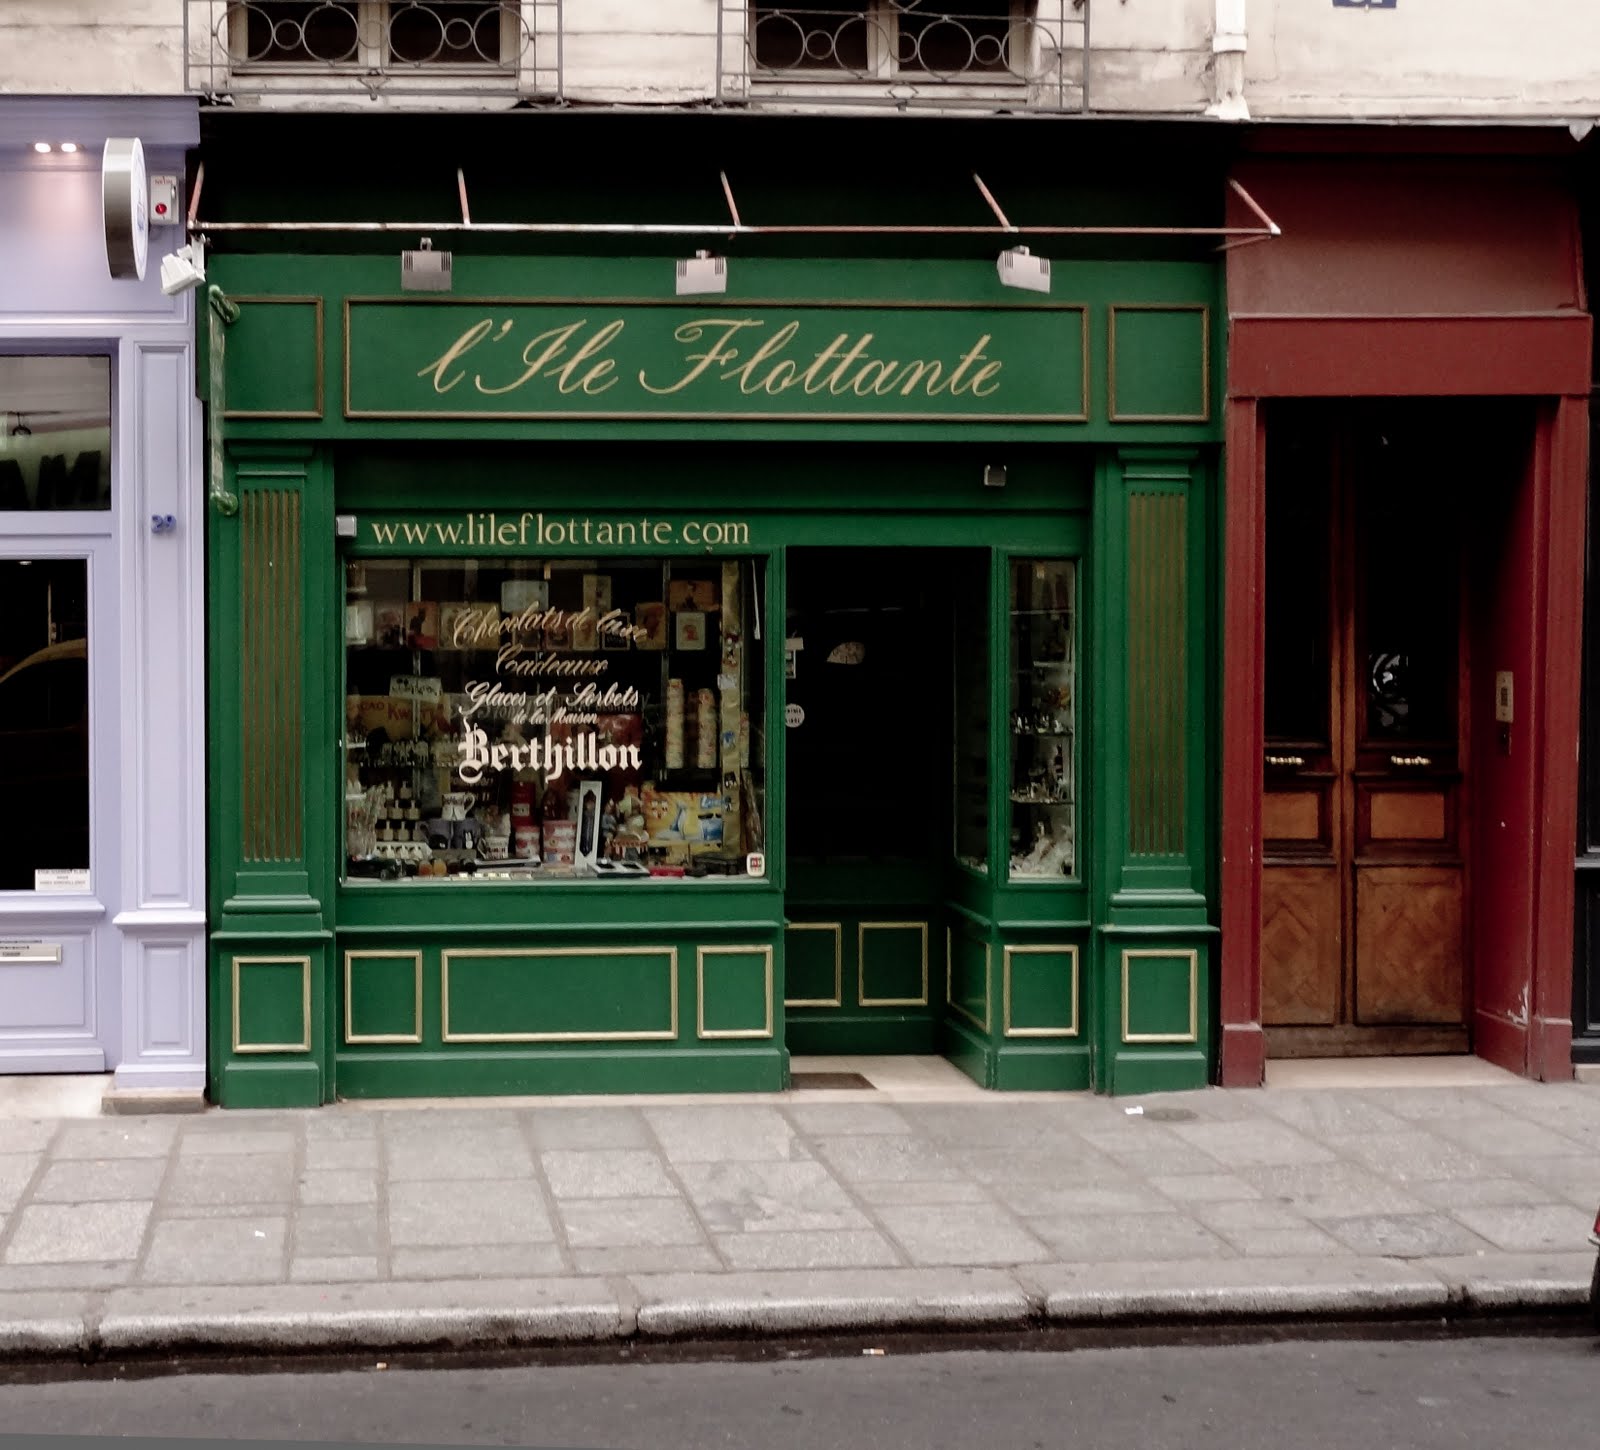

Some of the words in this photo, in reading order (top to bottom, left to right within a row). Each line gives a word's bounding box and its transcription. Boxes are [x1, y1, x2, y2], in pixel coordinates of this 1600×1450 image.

[418, 318, 624, 394] l'Ile
[639, 319, 1002, 396] Flottante
[371, 512, 750, 546] www.lileflottante.com
[453, 600, 564, 650] Chocolats
[565, 606, 591, 632] de
[495, 642, 609, 677] Cadeaux
[458, 680, 527, 715] Glaces
[534, 685, 558, 706] et
[565, 681, 639, 707] Sorbets
[511, 707, 528, 725] de
[529, 706, 547, 725] la
[548, 706, 599, 725] Maison
[457, 716, 643, 785] Berthillon
